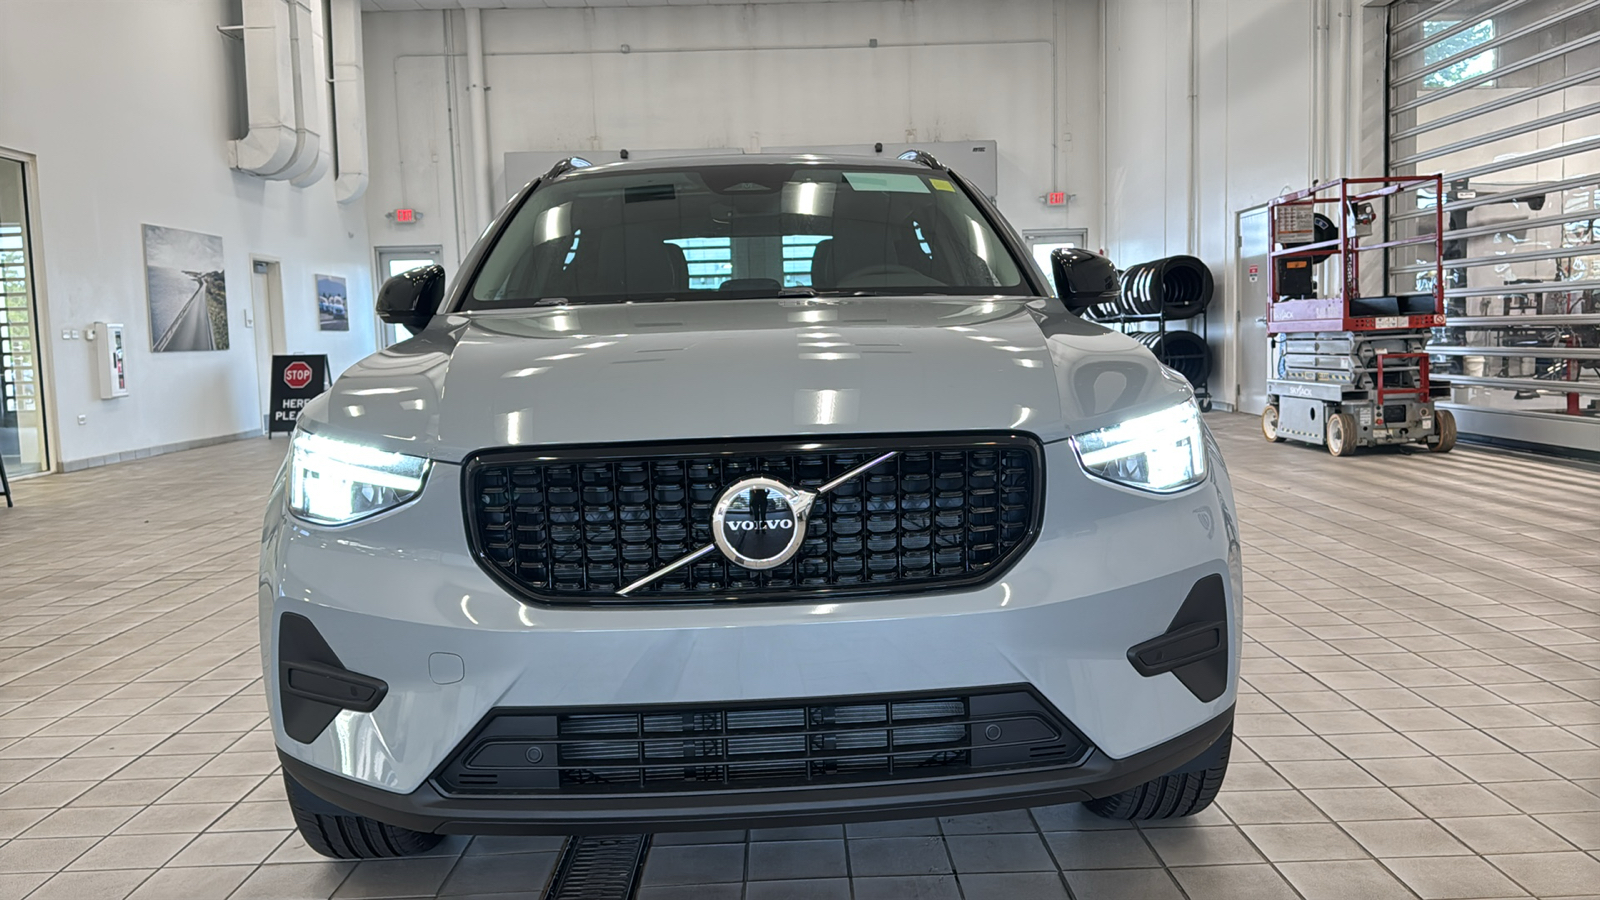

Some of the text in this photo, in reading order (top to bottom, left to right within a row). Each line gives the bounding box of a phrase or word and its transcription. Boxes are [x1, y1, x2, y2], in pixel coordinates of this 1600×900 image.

[1049, 192, 1064, 204] EXIT
[286, 370, 310, 380] STOP
[275, 411, 300, 421] PLE
[726, 519, 793, 531] VOLVO
